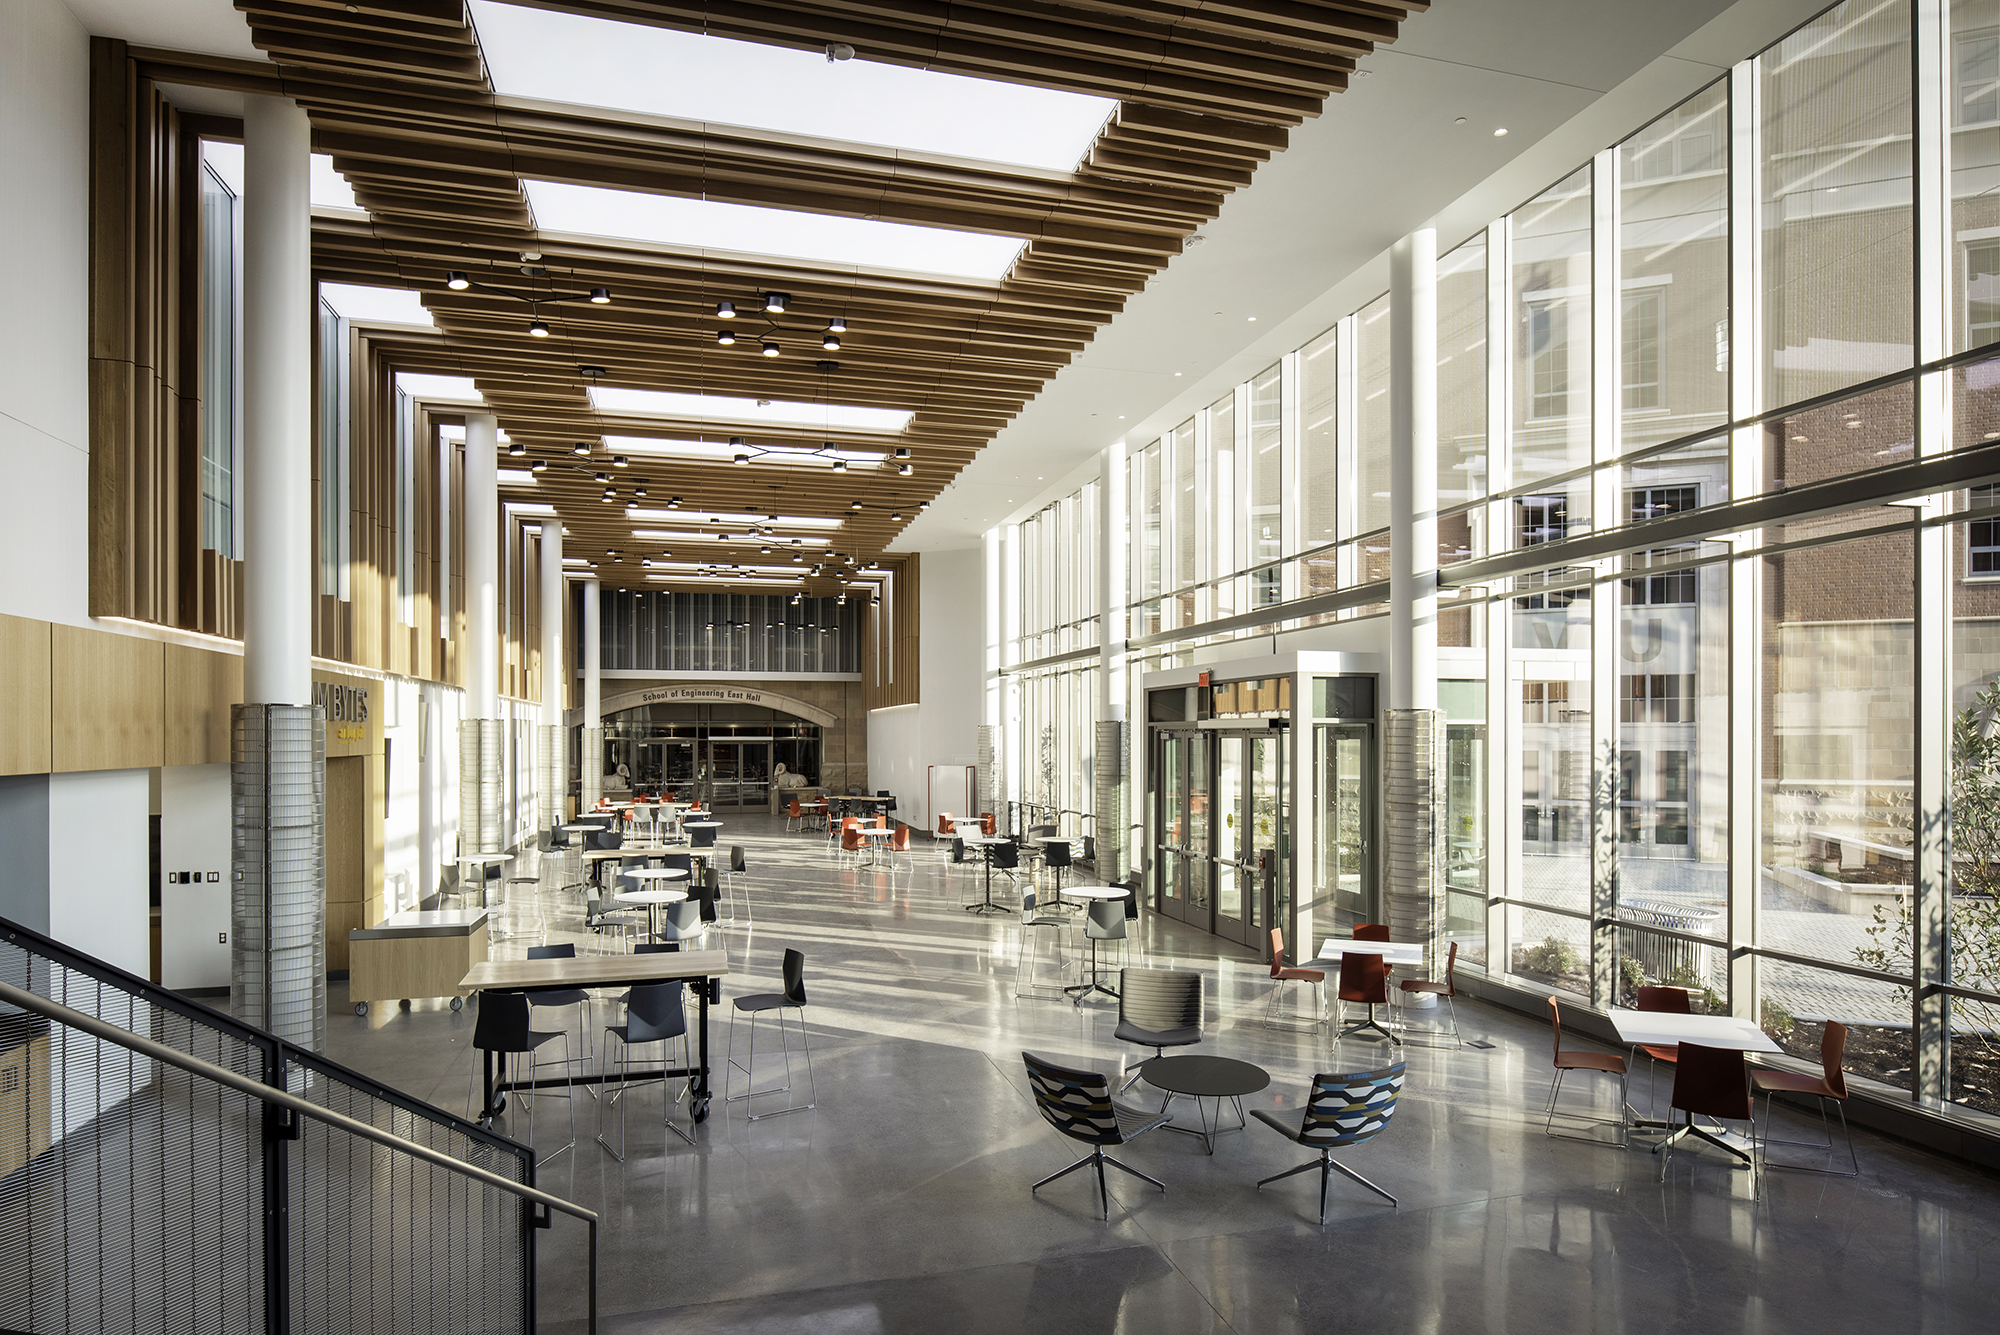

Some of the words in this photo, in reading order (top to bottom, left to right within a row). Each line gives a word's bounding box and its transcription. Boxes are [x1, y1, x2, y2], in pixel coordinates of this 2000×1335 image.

[1532, 617, 1663, 663] VU
[333, 684, 369, 722] BYTES
[642, 691, 668, 701] School
[670, 690, 678, 698] of
[681, 689, 725, 699] Engineering
[727, 690, 744, 699] East
[746, 692, 761, 702] Hall
